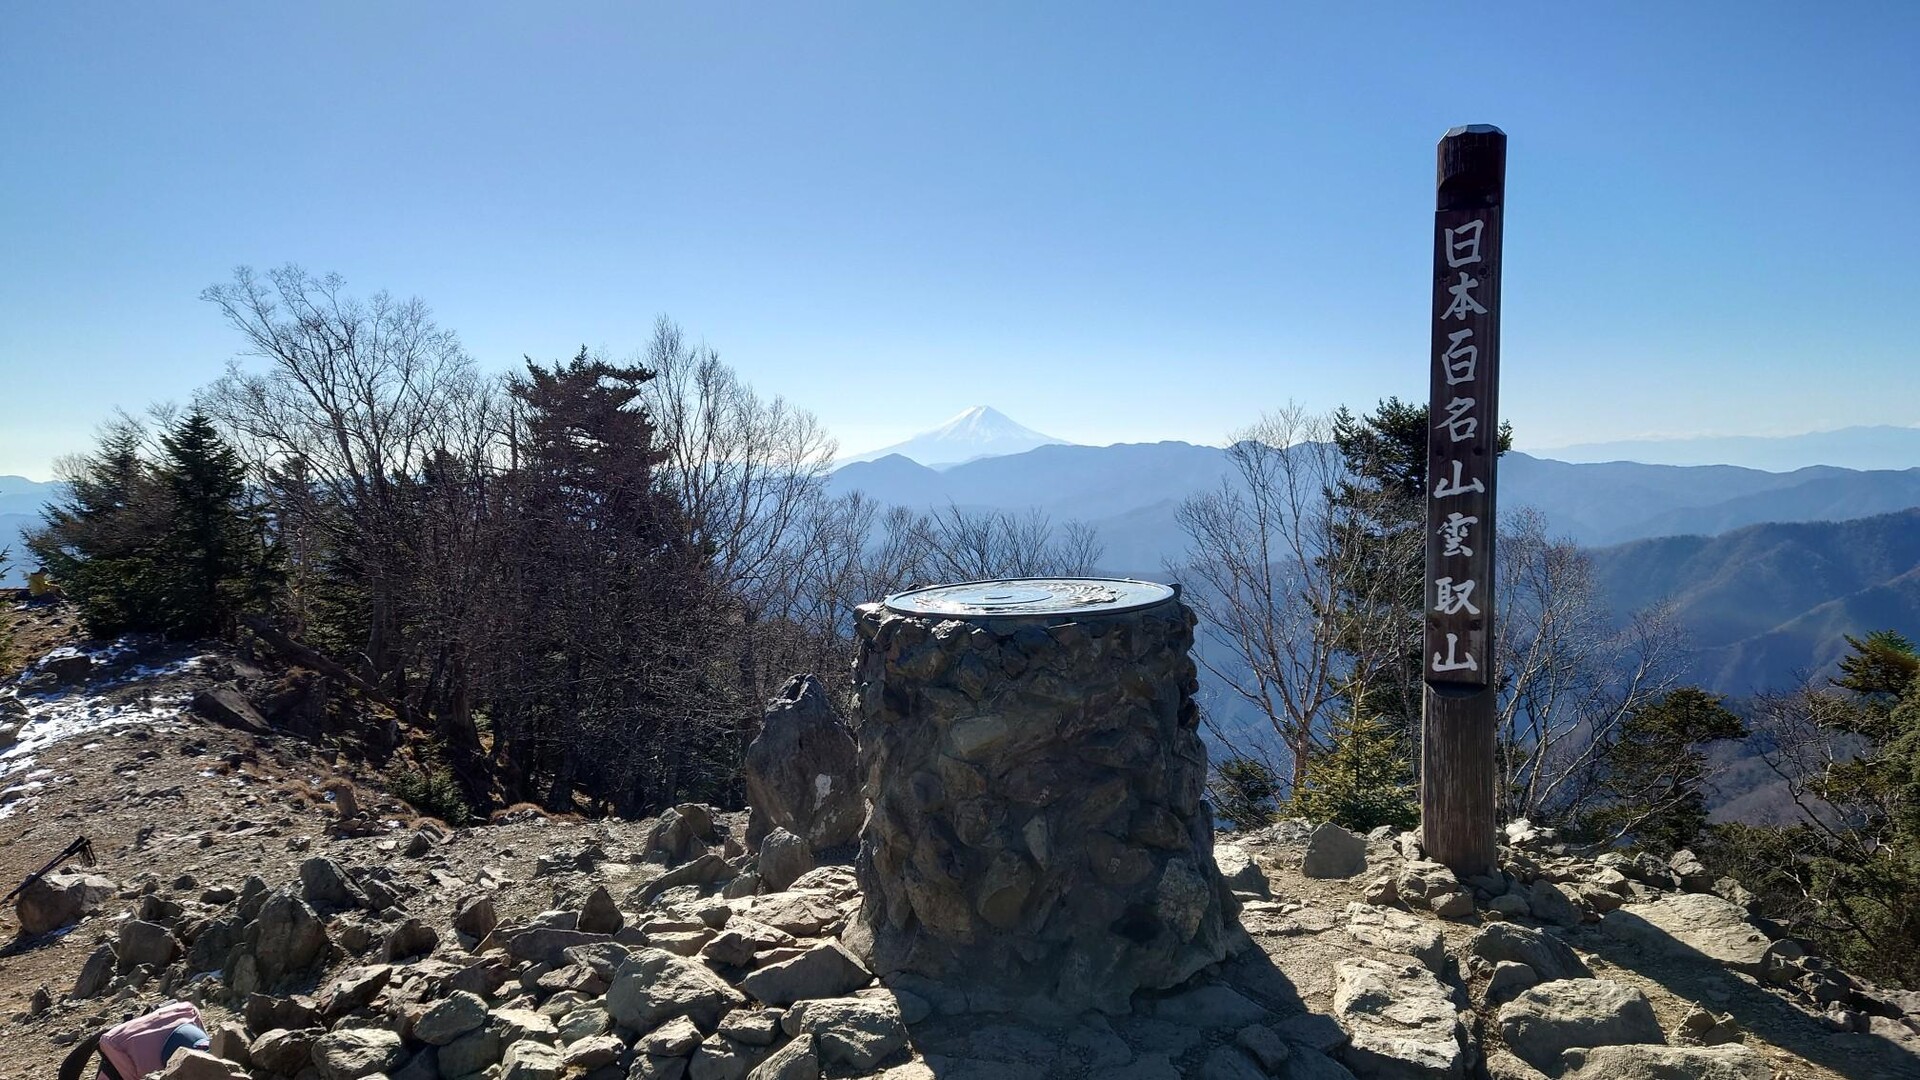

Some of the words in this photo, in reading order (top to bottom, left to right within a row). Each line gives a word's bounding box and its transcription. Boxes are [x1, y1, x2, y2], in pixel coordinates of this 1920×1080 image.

[1432, 219, 1487, 672] 日本百名山雲取山
